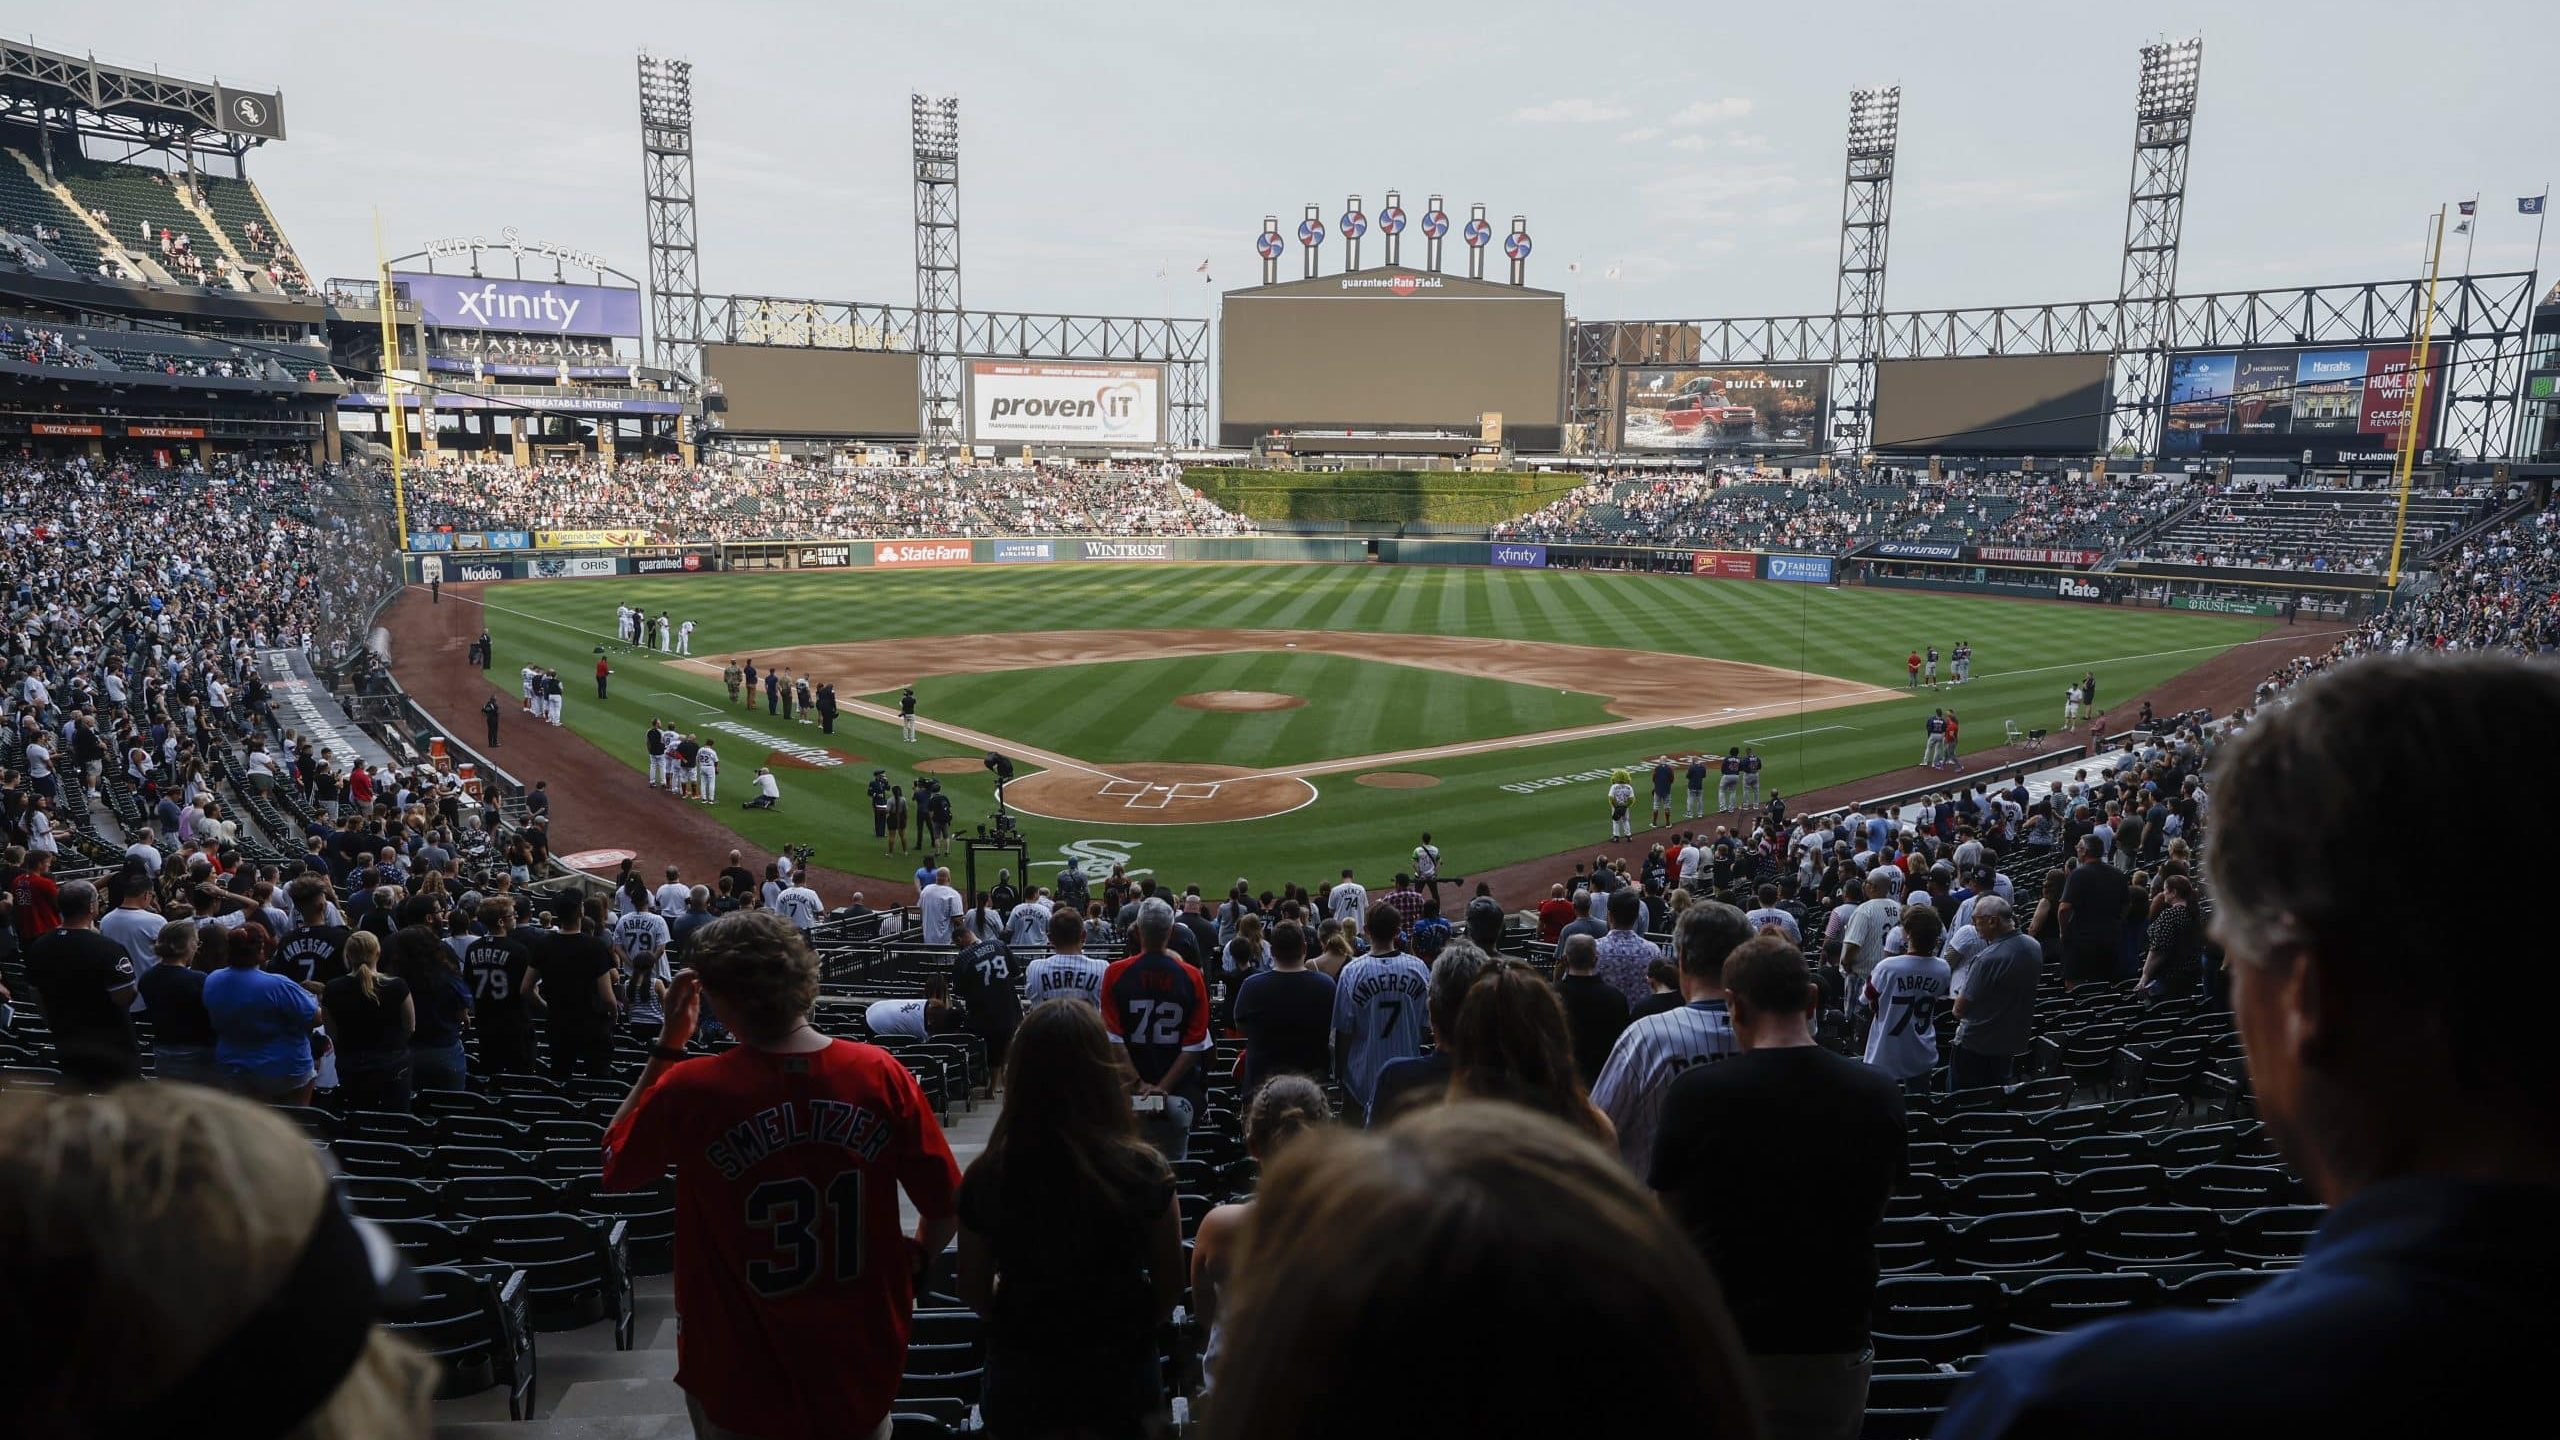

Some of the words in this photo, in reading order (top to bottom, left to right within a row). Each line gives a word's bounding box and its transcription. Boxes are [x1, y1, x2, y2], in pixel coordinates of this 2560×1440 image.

[424, 236, 489, 261] KIDS
[538, 240, 607, 275] ZONE
[1341, 277, 1393, 290] guaranteed
[1393, 277, 1414, 288] Rate
[458, 283, 581, 330] xfinity
[2384, 363, 2407, 374] HIT
[1725, 380, 1764, 390] BUILT
[1770, 379, 1805, 389] WILD
[2369, 374, 2404, 389] HOME
[2380, 388, 2416, 399] WITH
[520, 398, 580, 409] UNBEATABLE
[582, 400, 623, 410] INTERNET
[990, 397, 1096, 420] proven
[1110, 396, 1133, 417] IT
[43, 425, 68, 435] VIZZY
[139, 427, 167, 437] VIZZY
[2359, 452, 2400, 461] LANDING
[817, 547, 849, 556] STREAM
[1497, 547, 1537, 565] xfinity
[1655, 551, 1675, 560] THE
[1899, 544, 1953, 556] HYUNDAI
[1980, 547, 2046, 562] WHITTINGHAM
[2050, 549, 2083, 564] MEATS
[580, 560, 609, 571] ORIS
[639, 557, 682, 573] guaranteed
[817, 556, 838, 565] YOUR
[1787, 562, 1828, 572] FANDUEL
[461, 566, 502, 581] Modelo
[2058, 577, 2101, 597] Rate
[2198, 600, 2229, 612] RUSH
[788, 903, 797, 918] 7
[1343, 897, 1358, 911] 74
[623, 919, 655, 932] ABREU
[1024, 918, 1034, 933] 7
[1759, 915, 1783, 926] SMITH
[625, 931, 652, 951] 79
[282, 937, 335, 962] ANDERSON
[469, 948, 510, 966] ABREU
[298, 958, 315, 981] 7
[975, 954, 1010, 987] 79
[472, 968, 510, 1001] 79
[1041, 970, 1099, 992] ABREU
[1897, 975, 1940, 993] ABREU
[1352, 973, 1427, 1008] ANDERSON
[1128, 999, 1184, 1045] 72
[1379, 1001, 1401, 1039] 7
[1888, 995, 1937, 1036] 79
[706, 1099, 895, 1181] SMELTZER
[745, 1169, 865, 1297] 31
